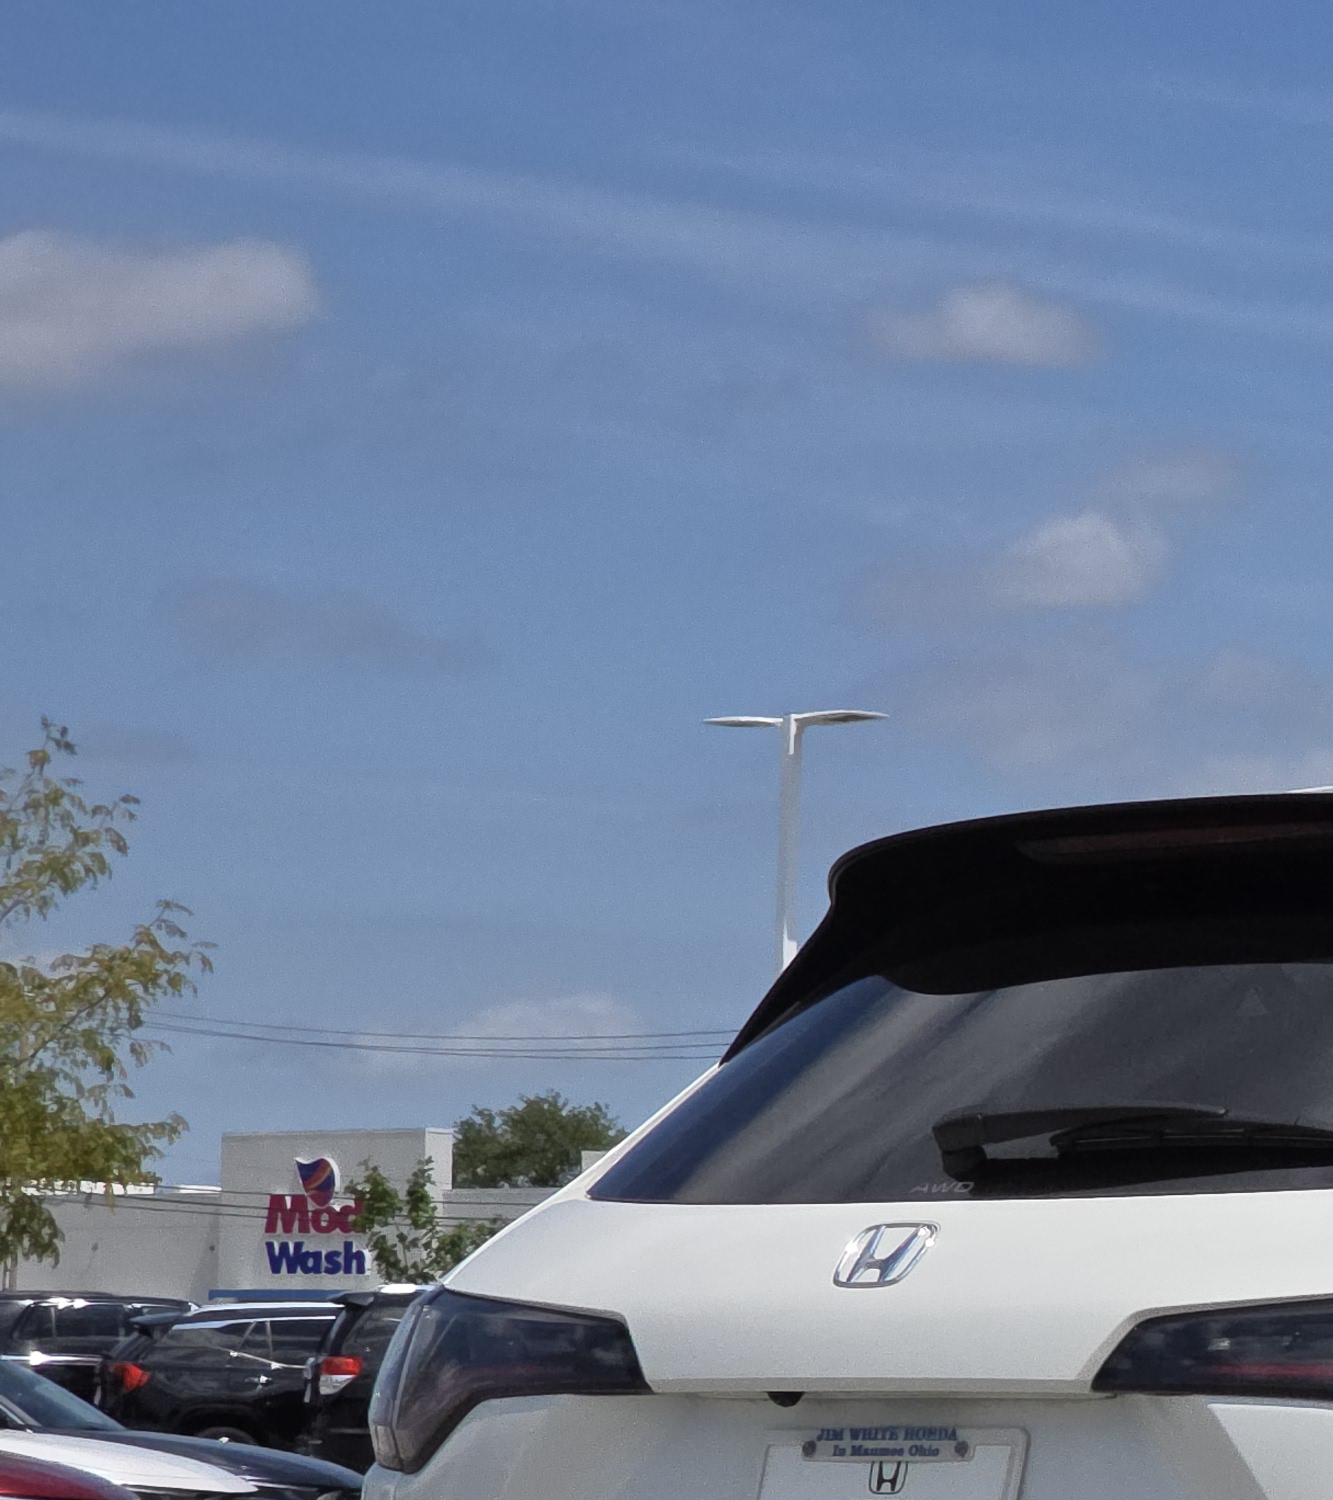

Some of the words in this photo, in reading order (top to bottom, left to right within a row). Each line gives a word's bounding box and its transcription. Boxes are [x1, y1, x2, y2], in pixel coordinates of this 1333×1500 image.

[908, 1181, 974, 1193] AWD
[265, 1240, 366, 1275] Wash
[817, 1427, 844, 1441] JIM
[850, 1426, 899, 1441] WHITE
[903, 1426, 957, 1441] HONDA
[908, 1445, 939, 1456] Ohio
